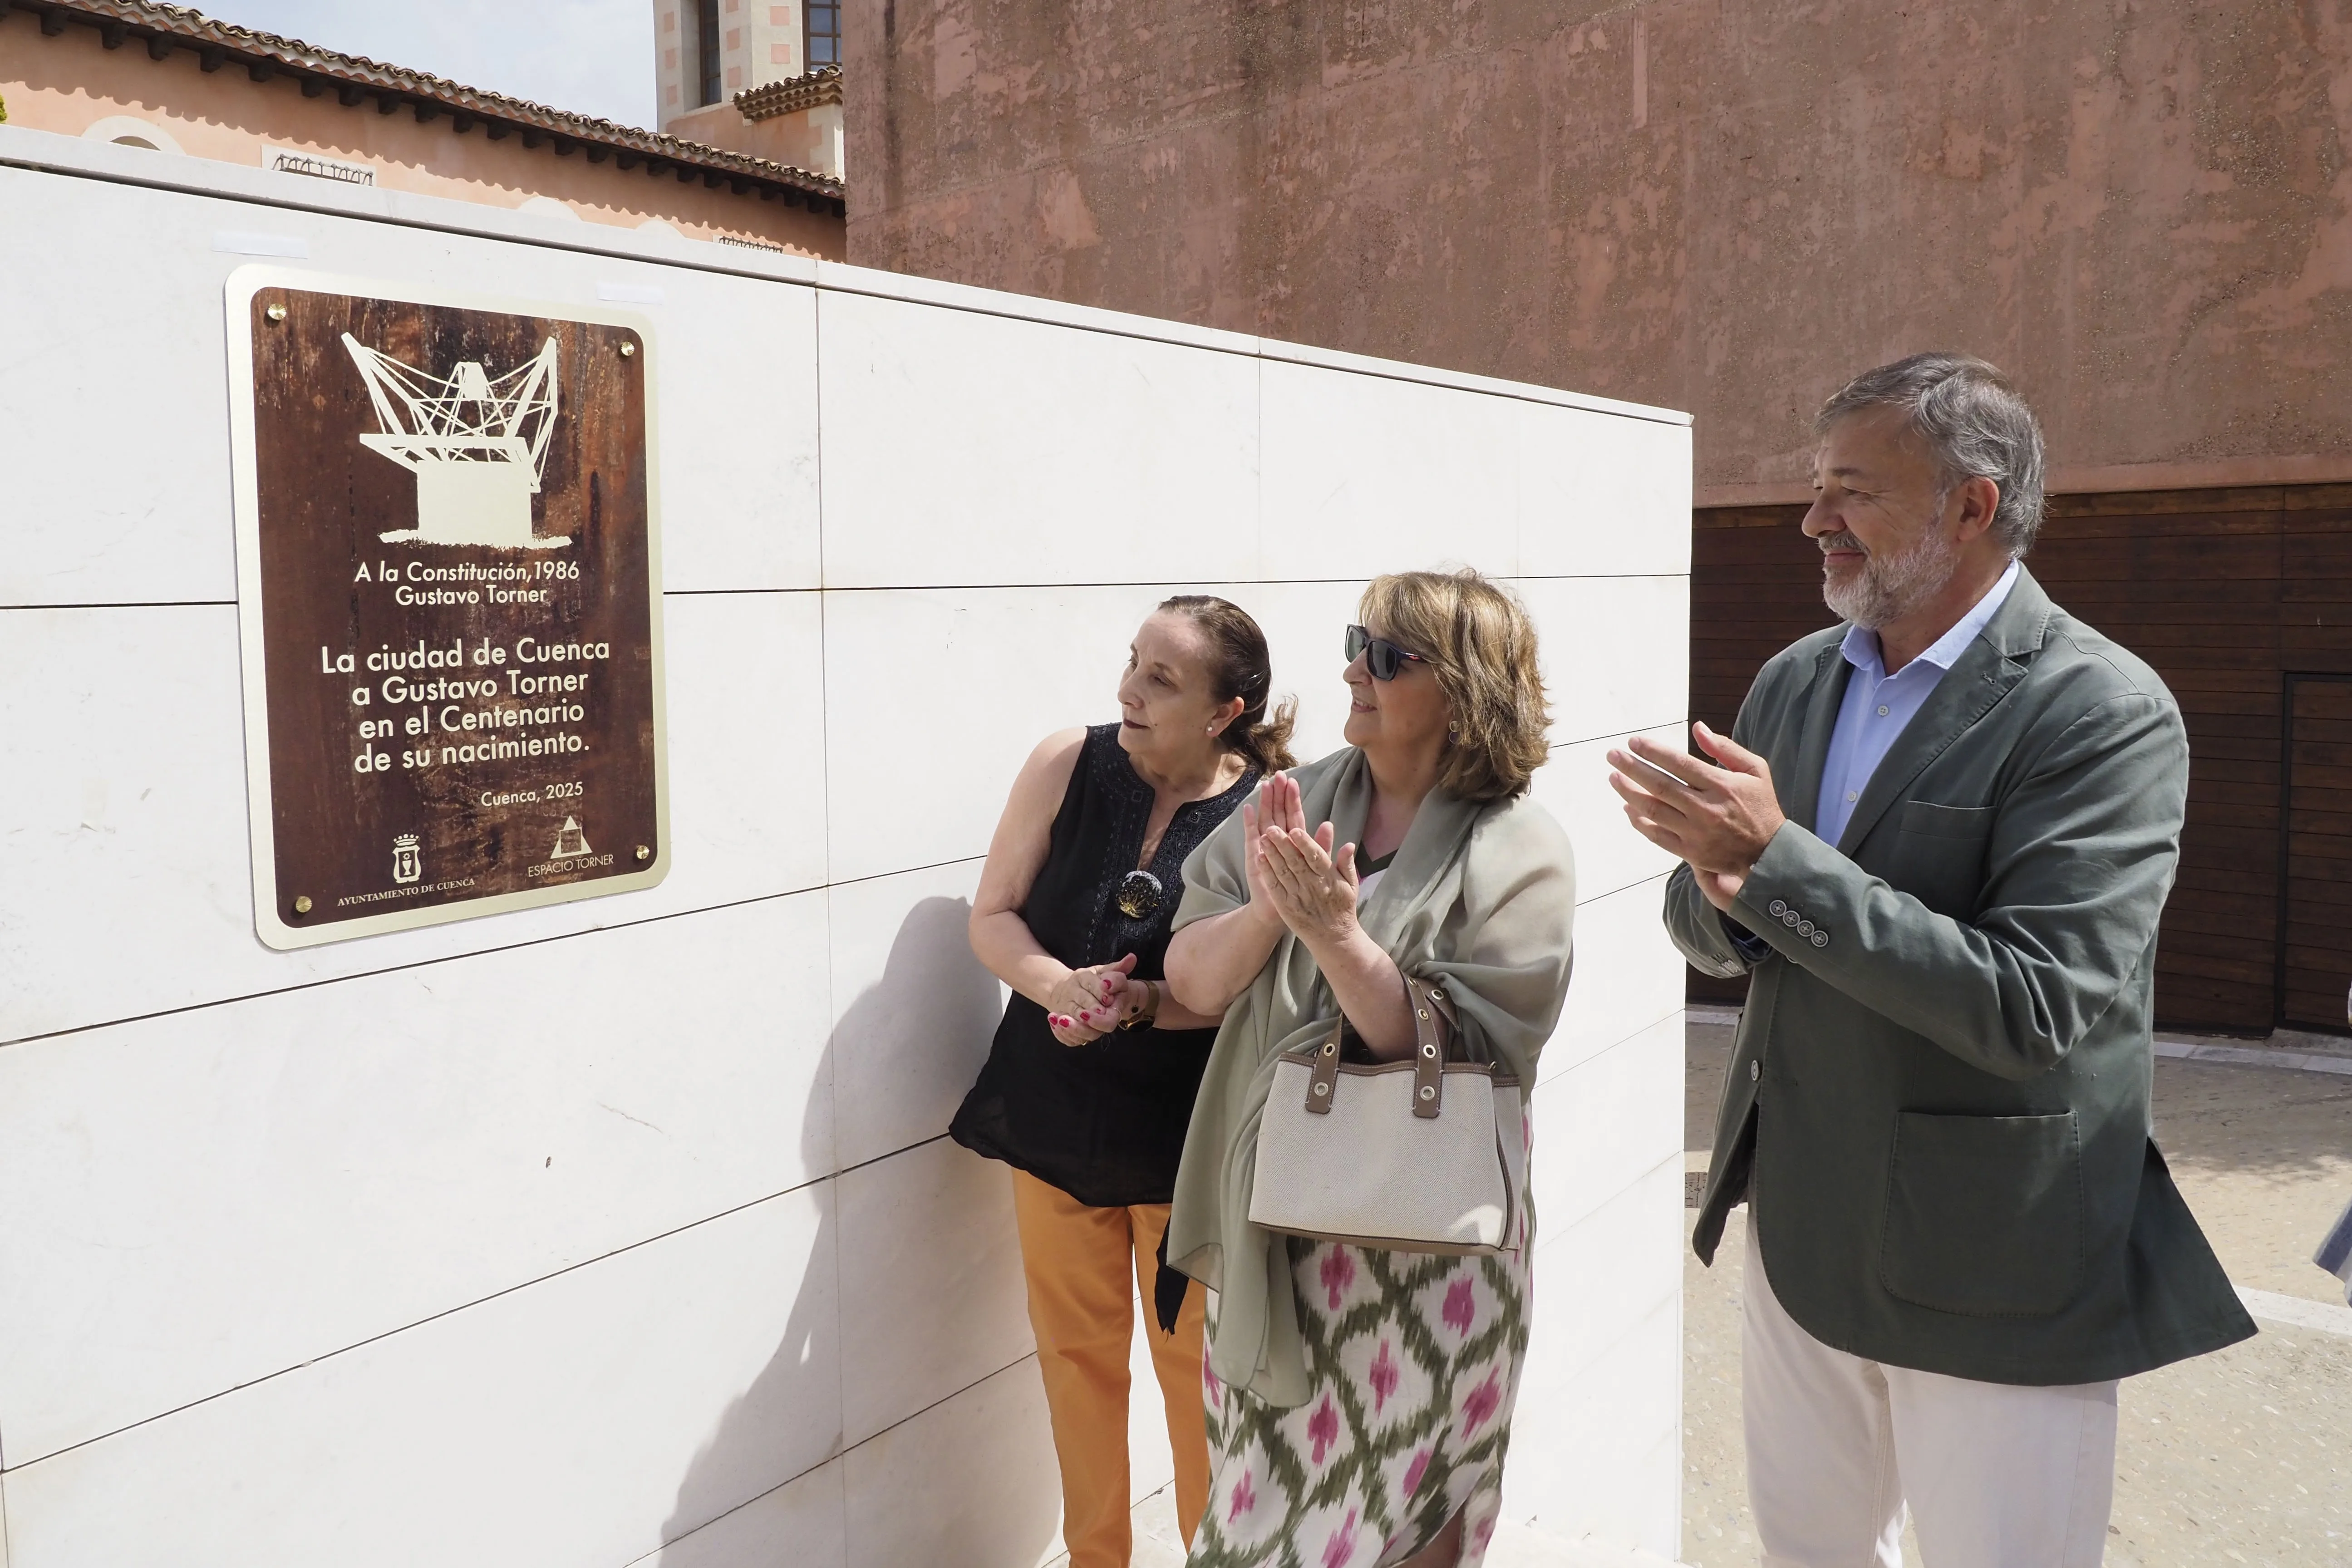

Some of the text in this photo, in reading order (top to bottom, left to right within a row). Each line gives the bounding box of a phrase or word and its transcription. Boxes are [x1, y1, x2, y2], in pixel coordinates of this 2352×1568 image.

[354, 561, 372, 582] A
[379, 560, 399, 582] la
[395, 585, 547, 606] Gustavo Torner
[322, 637, 610, 673] La ciudad de Cuenca
[352, 669, 589, 706] a Gustavo Torner
[359, 698, 584, 739] en el Centenario
[354, 732, 590, 773] de su nacimiento.
[481, 781, 583, 807] Cuenca, 2025
[527, 854, 615, 878] ESPACIO TORNER
[337, 878, 476, 907] AYUNTAMIENTO DE CUENCA
